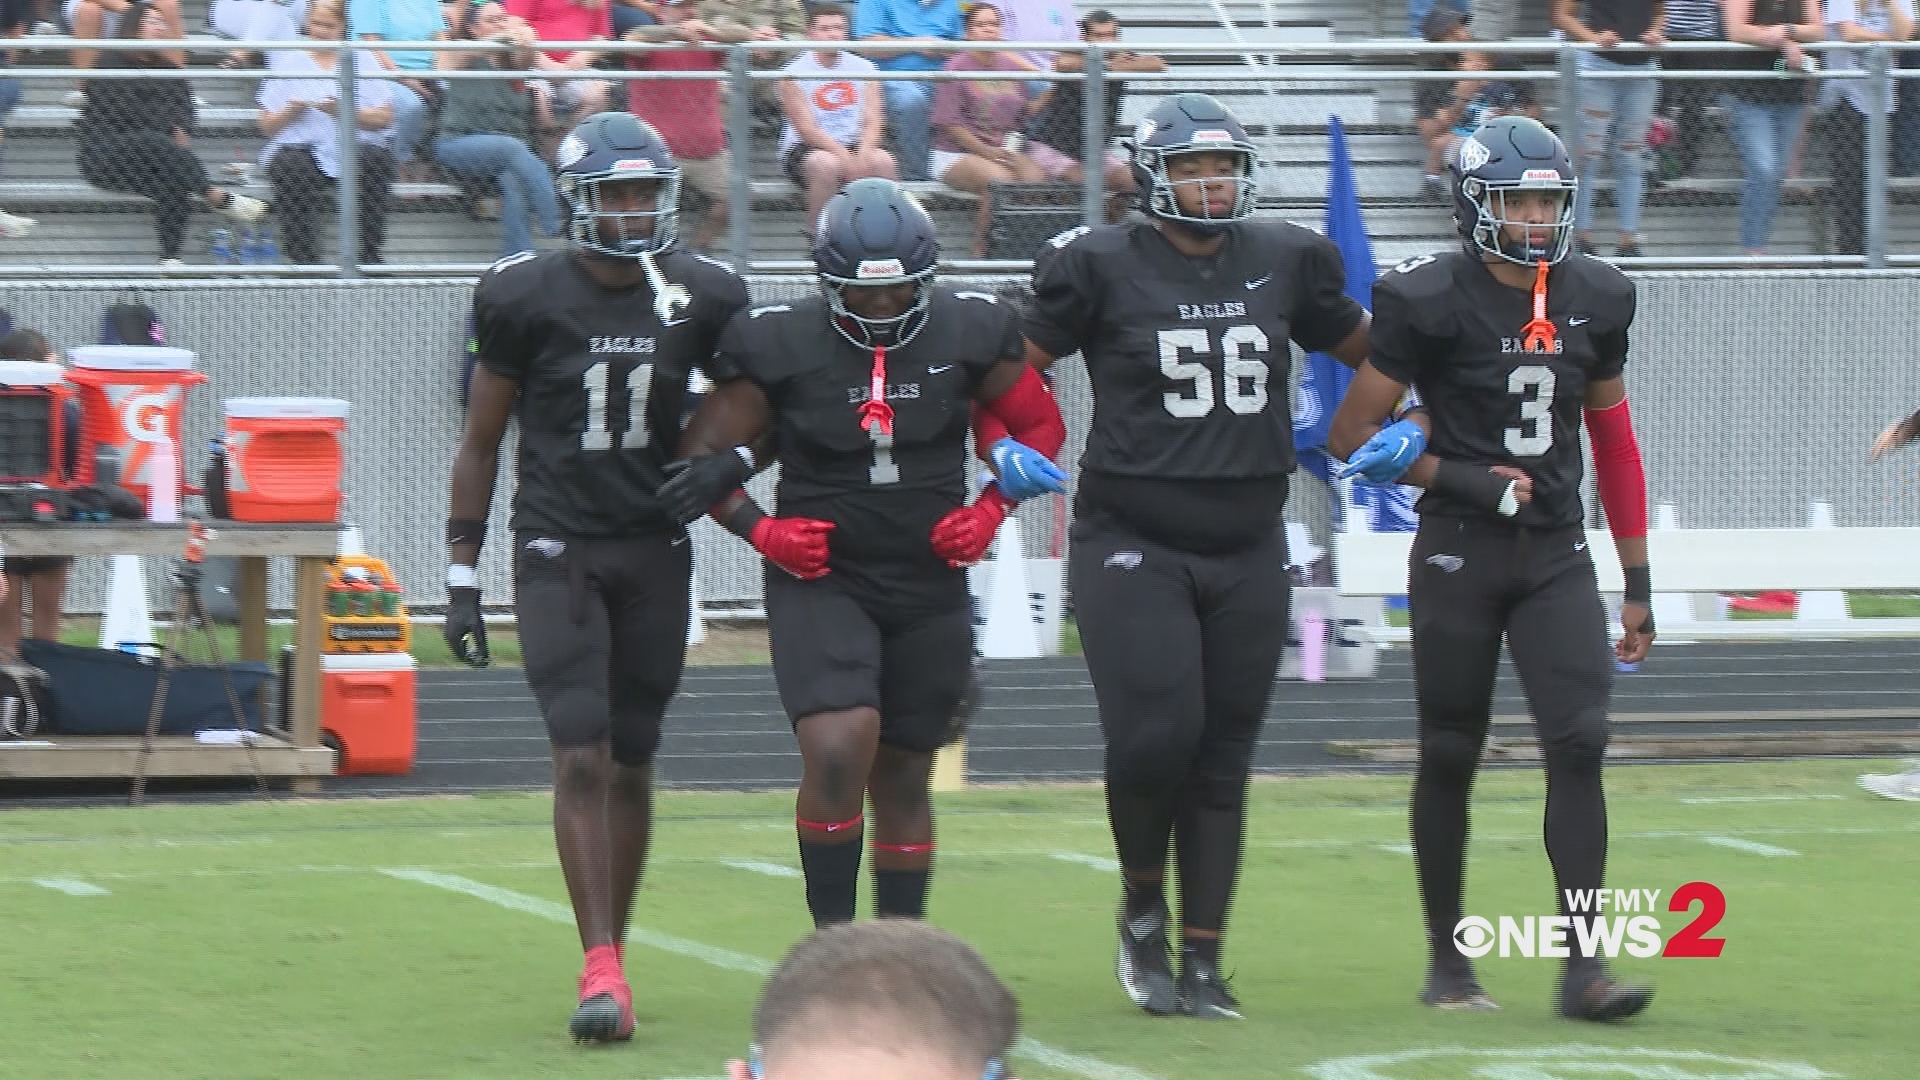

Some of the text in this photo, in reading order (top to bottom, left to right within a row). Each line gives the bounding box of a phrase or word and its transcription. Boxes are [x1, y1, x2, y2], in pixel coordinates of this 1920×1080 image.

[1177, 301, 1247, 320] EAGLES
[588, 337, 657, 353] EAGLES
[1157, 325, 1270, 418] 56
[122, 393, 170, 443] G
[581, 361, 655, 450] 11
[847, 383, 921, 403] EALES
[1503, 365, 1557, 456] 3
[869, 417, 900, 484] 1
